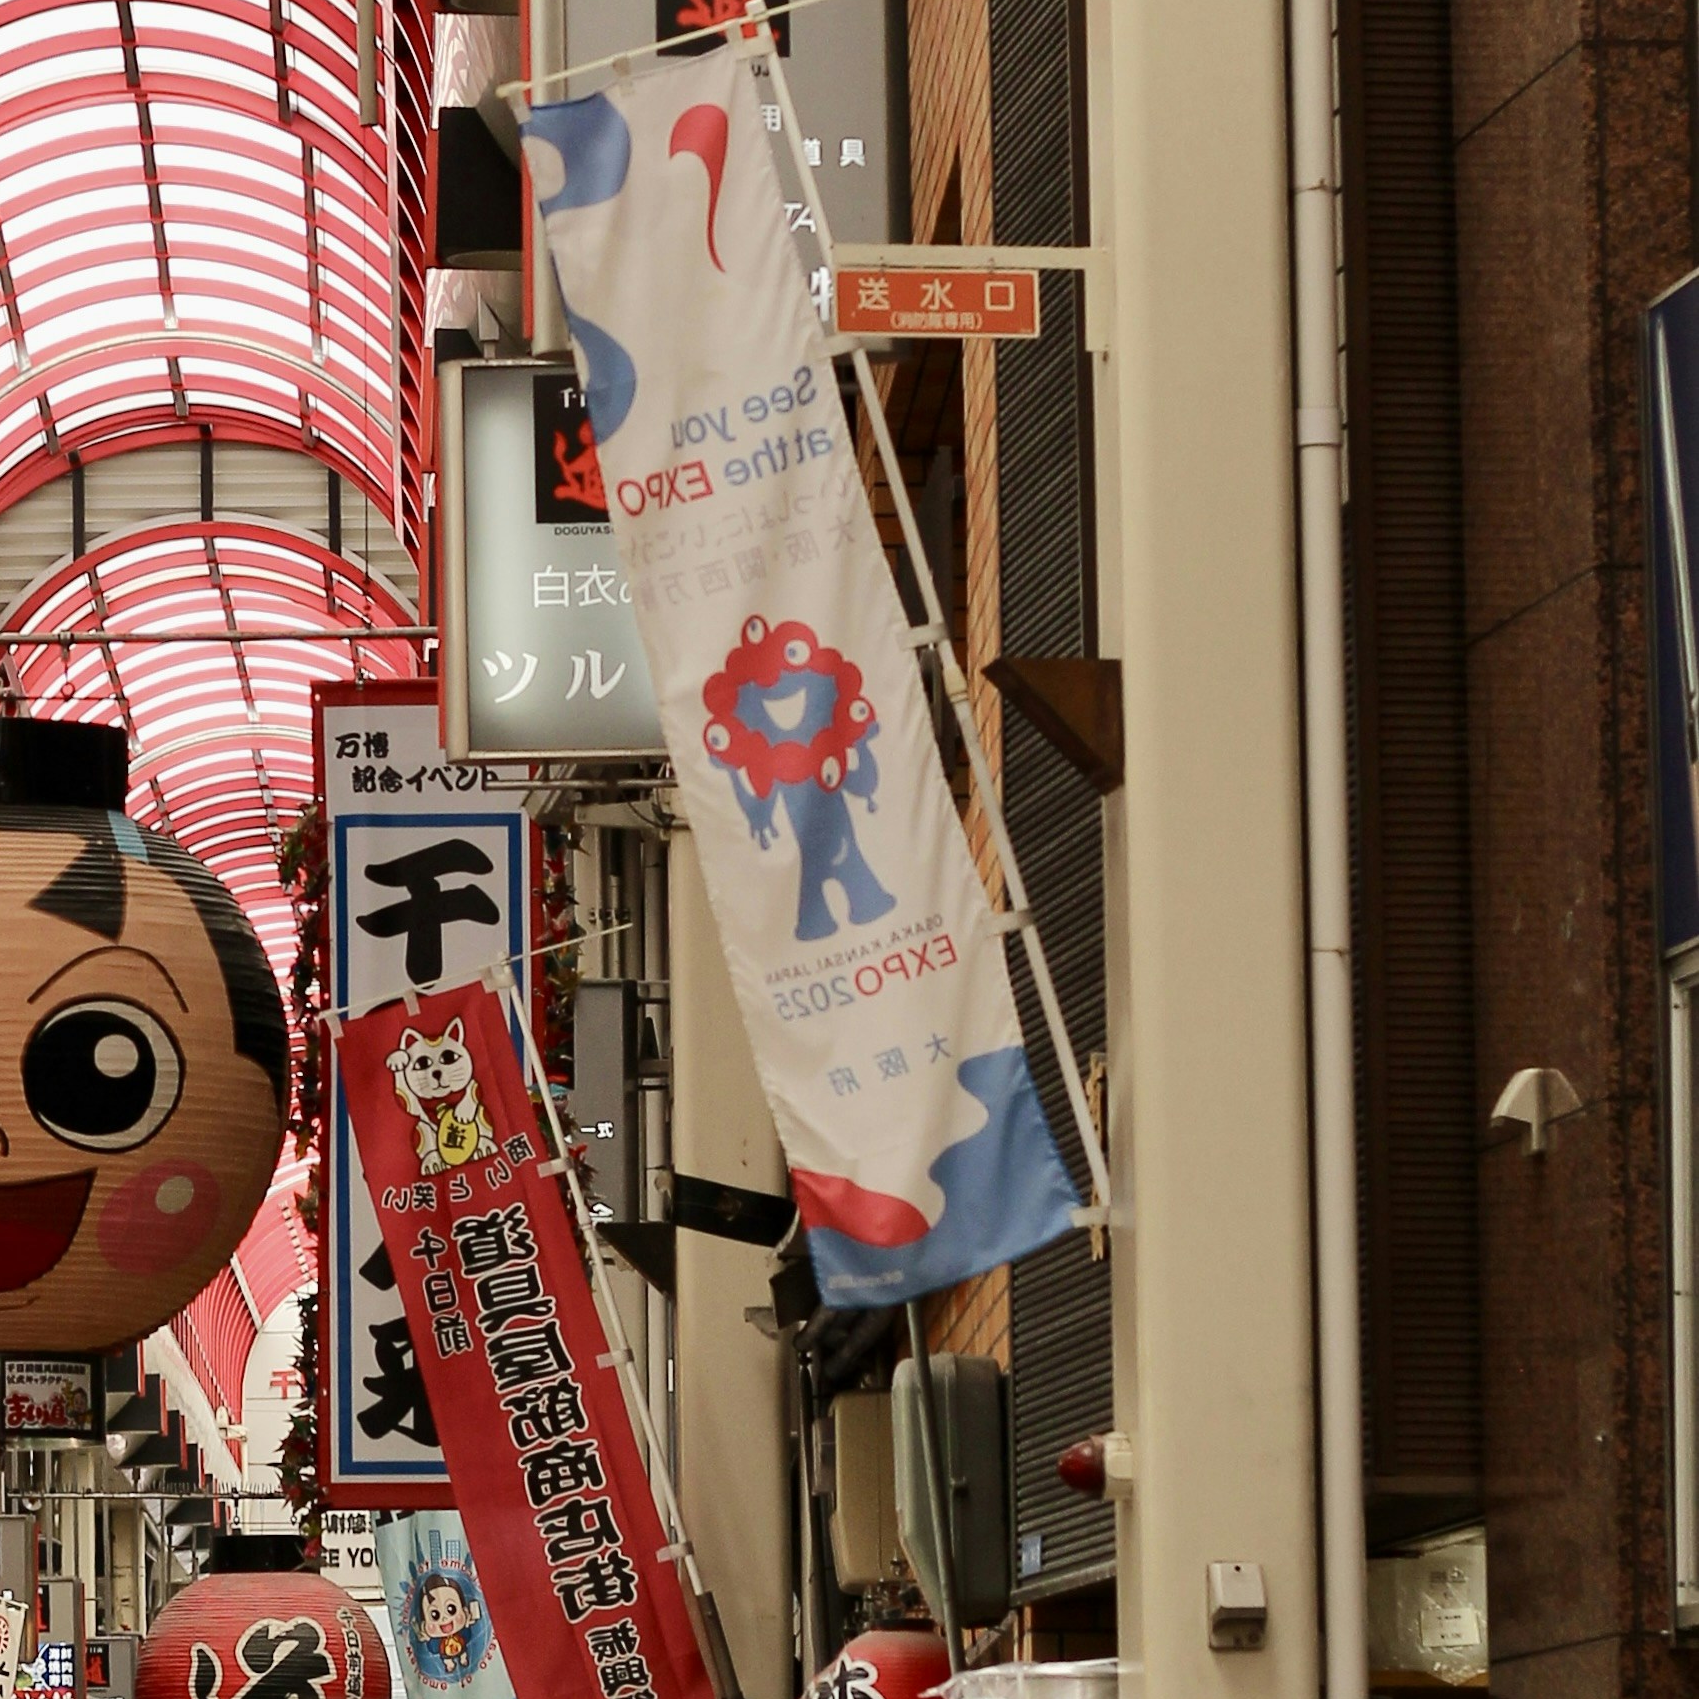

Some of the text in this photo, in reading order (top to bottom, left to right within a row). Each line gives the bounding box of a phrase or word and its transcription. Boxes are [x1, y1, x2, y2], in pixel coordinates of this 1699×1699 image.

[857, 277, 1017, 313] 送水口
[554, 524, 615, 537] DOGUYAS
[335, 731, 391, 762] 万博
[347, 1547, 379, 1569] YO
